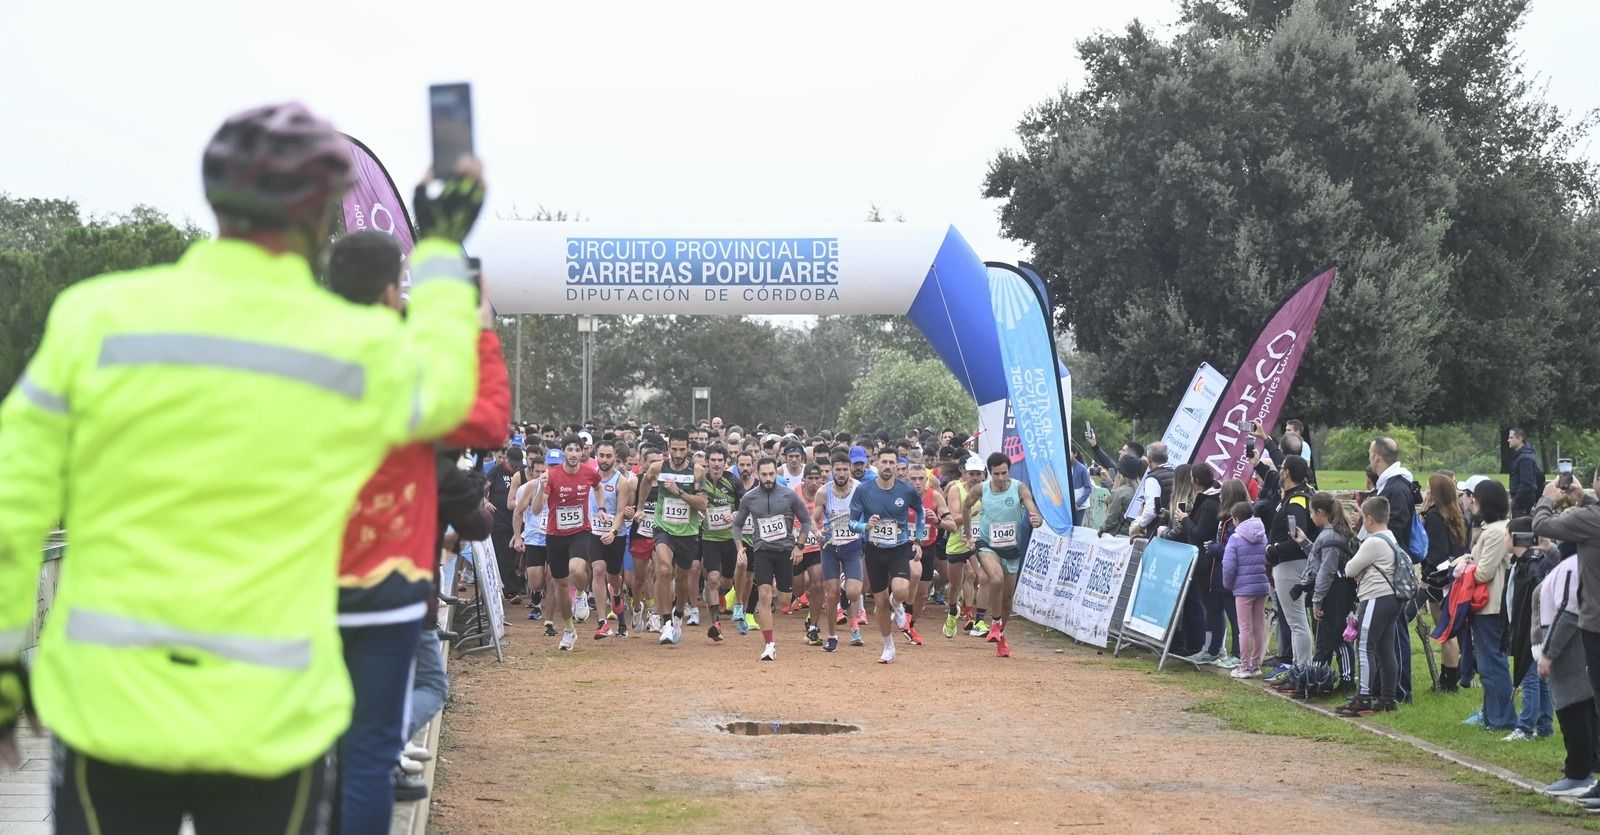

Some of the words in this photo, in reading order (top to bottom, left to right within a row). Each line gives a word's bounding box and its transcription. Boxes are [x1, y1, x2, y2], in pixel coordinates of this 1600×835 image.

[567, 240, 666, 260] CIRCUITO
[676, 240, 805, 260] PROVINCIAL
[812, 240, 838, 260] DE
[567, 261, 693, 284] CARRERAS
[702, 261, 838, 284] POPULARES
[566, 285, 690, 302] DIPUTACIÓN
[705, 288, 728, 302] DE
[743, 285, 840, 302] CÓRDOBA
[560, 511, 580, 522] 555
[666, 506, 688, 516] 1197
[762, 521, 783, 534] 1150
[874, 525, 893, 536] 543
[992, 528, 1014, 538] 1040
